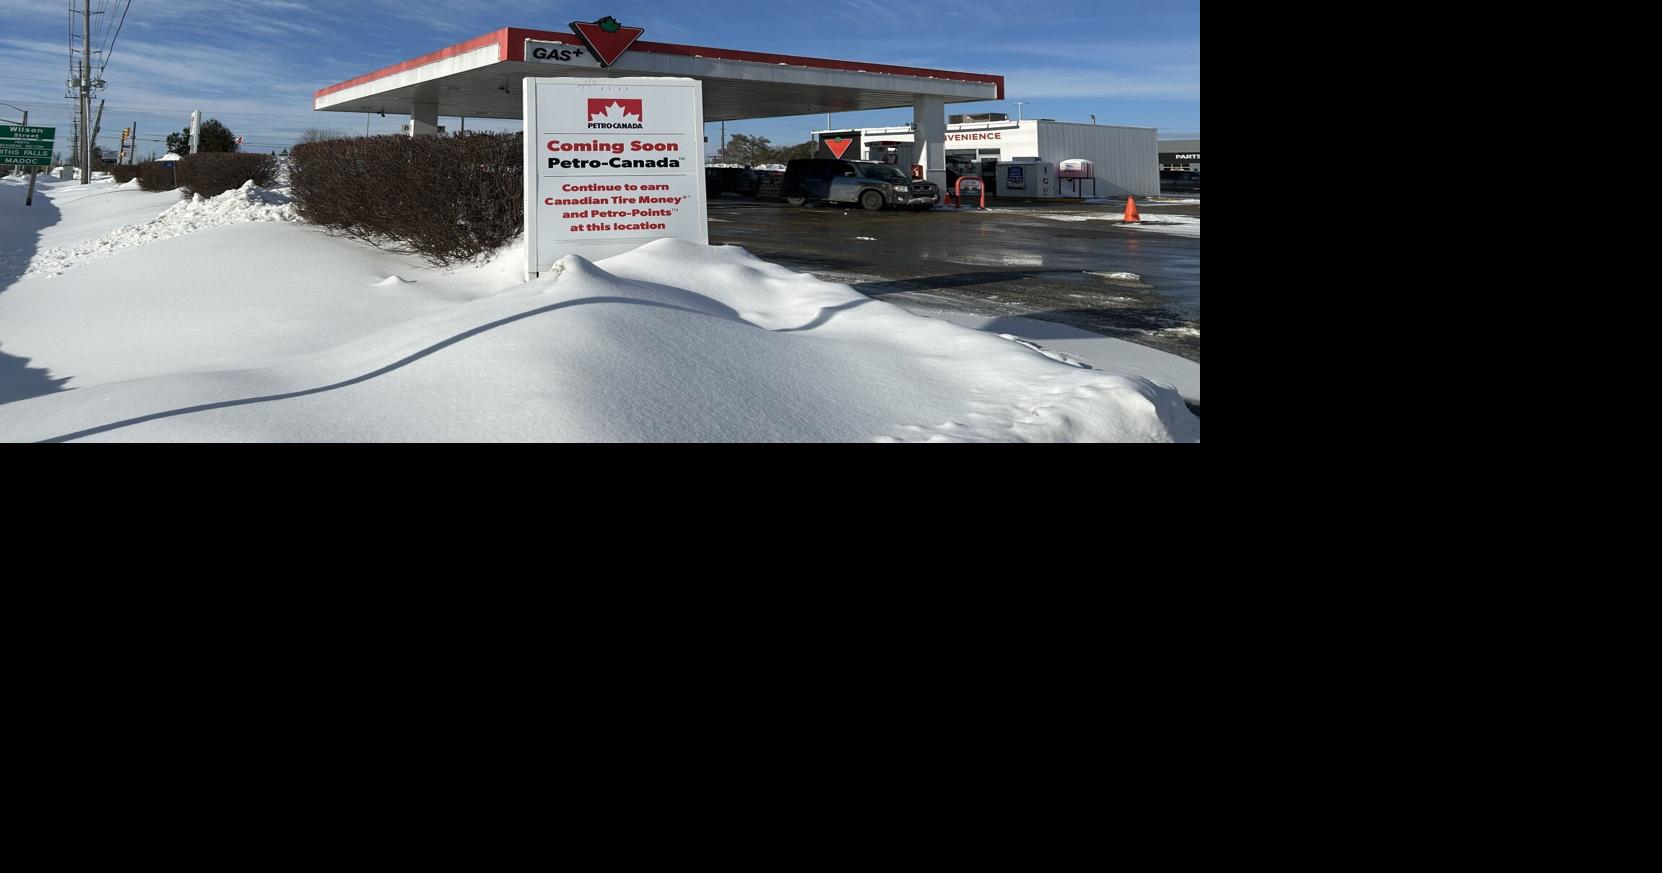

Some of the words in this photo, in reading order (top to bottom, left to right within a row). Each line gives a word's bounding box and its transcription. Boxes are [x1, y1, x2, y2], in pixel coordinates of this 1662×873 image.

[546, 140, 624, 154] Coming
[630, 140, 678, 152] Soon
[23, 149, 48, 157] FALLS
[562, 183, 622, 192] Continue
[624, 183, 638, 192] to
[544, 196, 609, 205] Canadian
[611, 196, 636, 204] Tire
[562, 210, 589, 219] and
[570, 223, 584, 232] at
[586, 222, 611, 231] this
[613, 221, 666, 231] location
